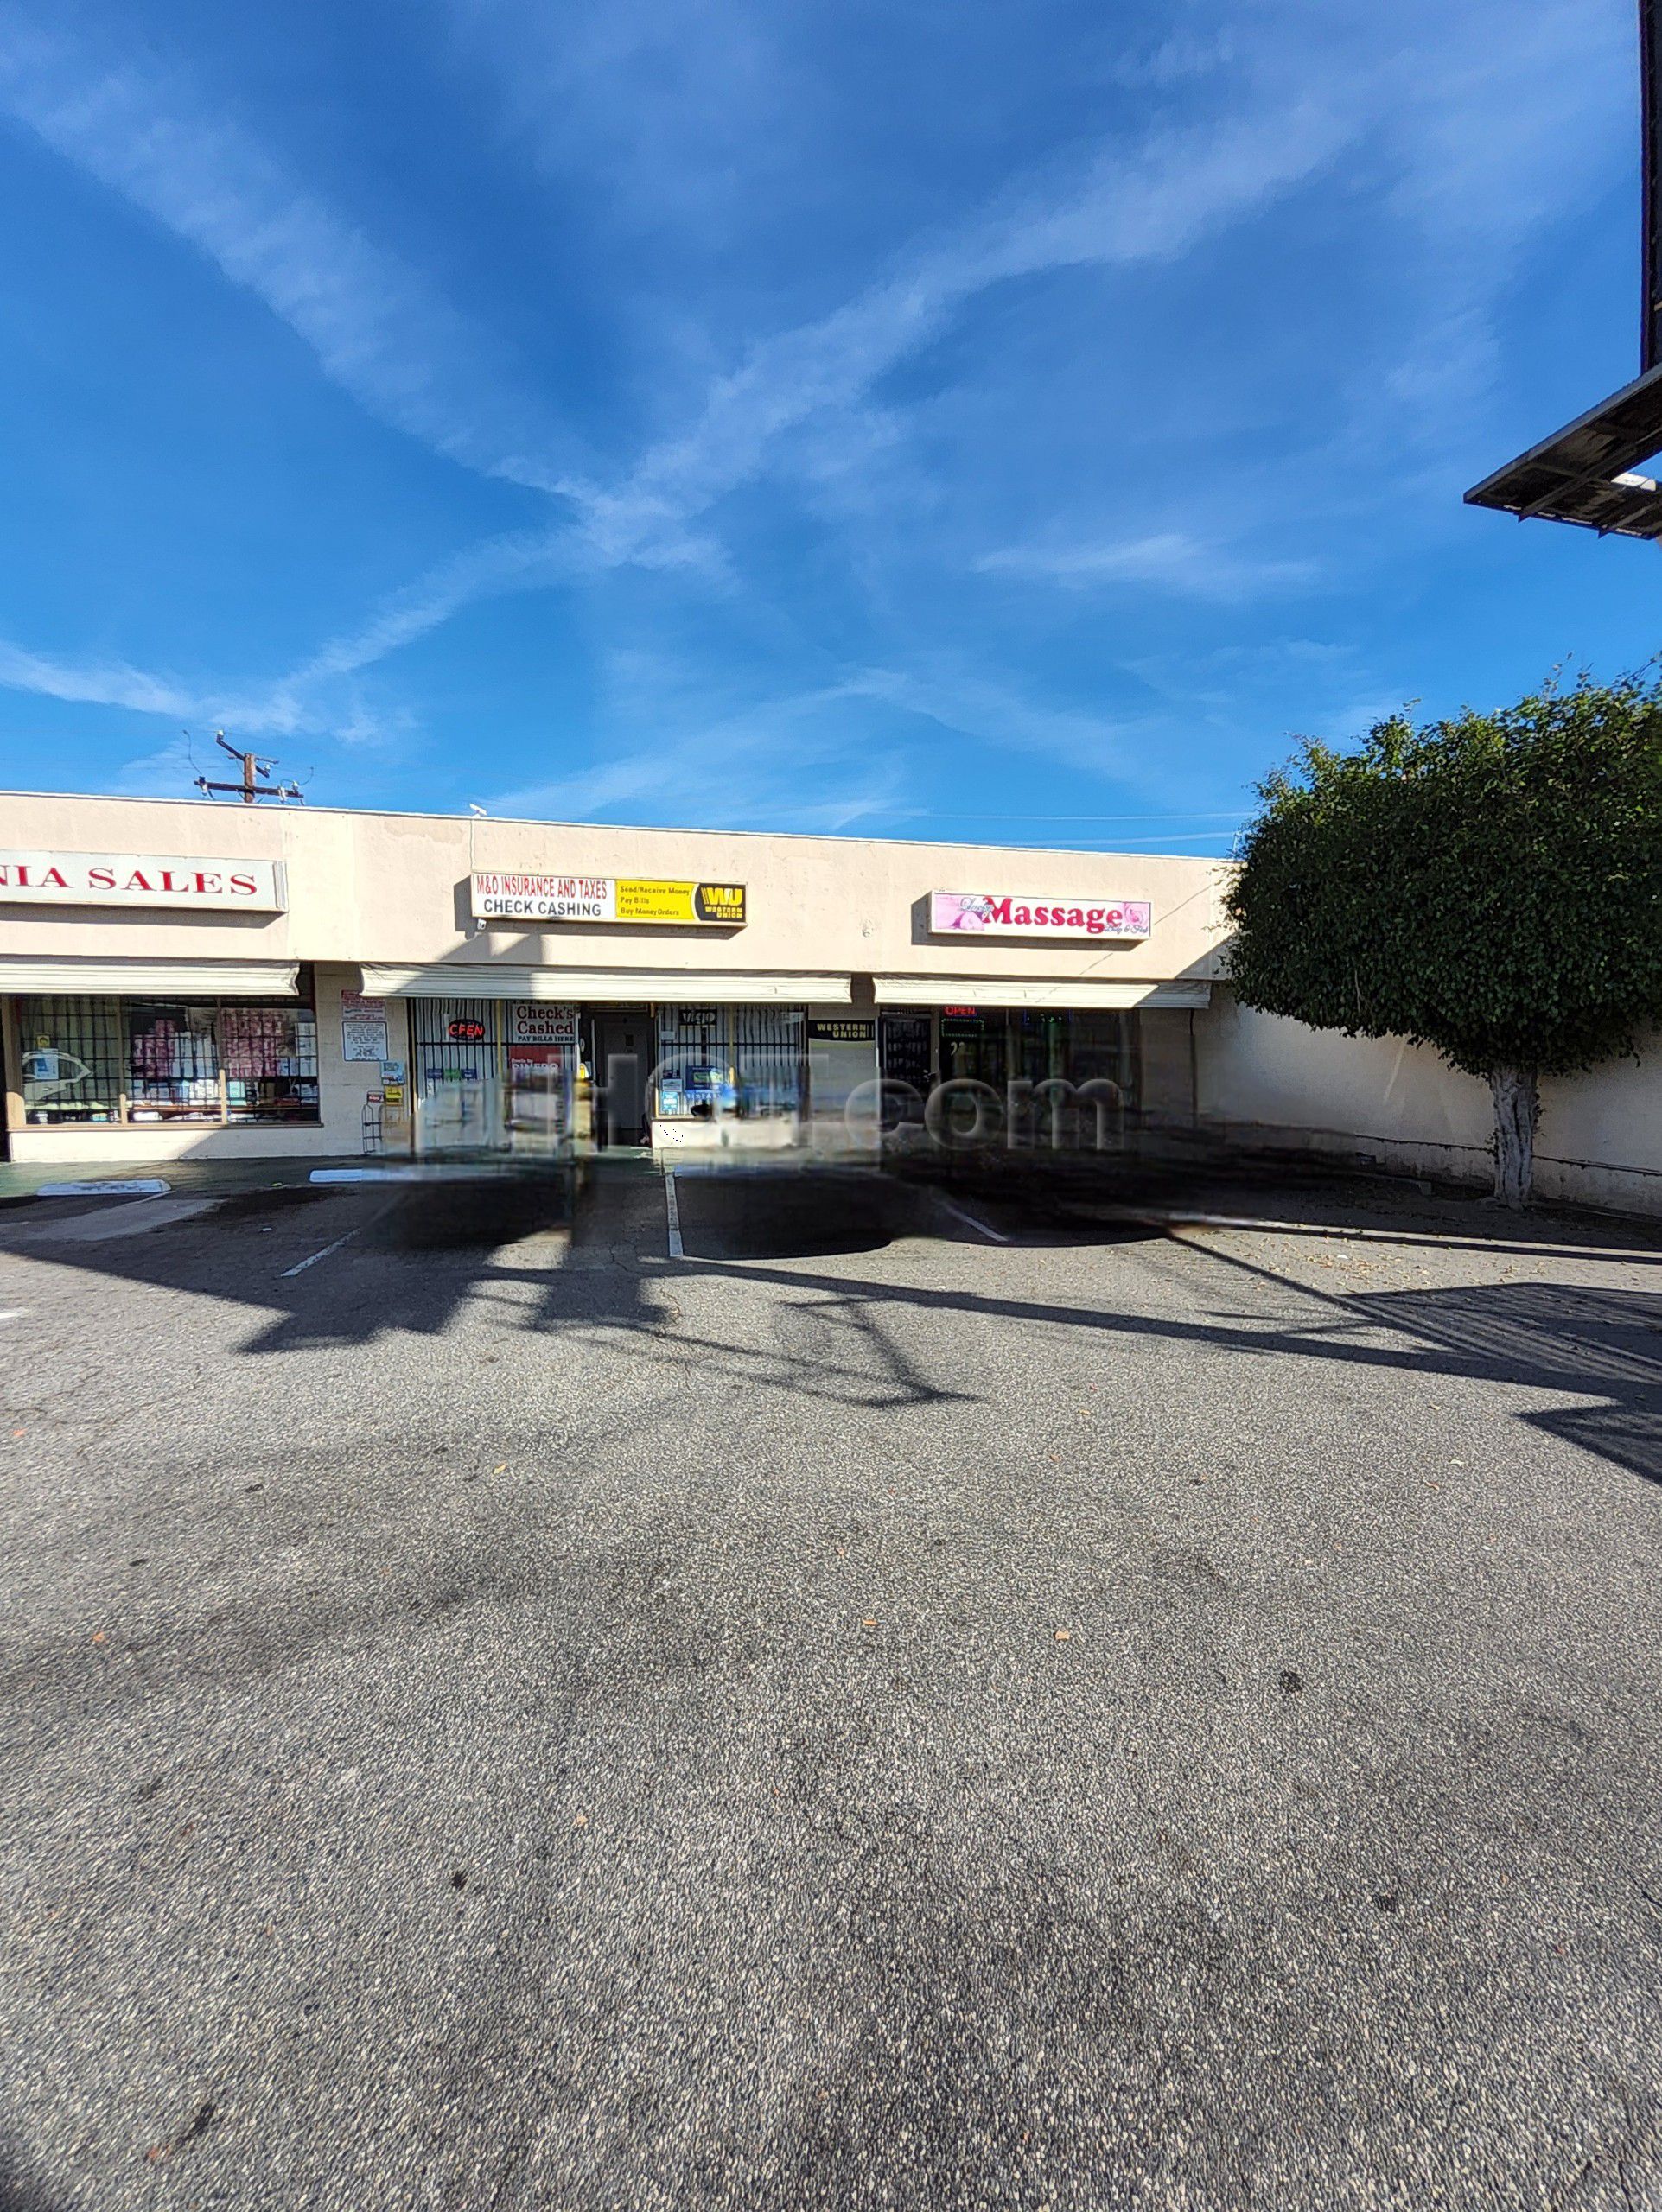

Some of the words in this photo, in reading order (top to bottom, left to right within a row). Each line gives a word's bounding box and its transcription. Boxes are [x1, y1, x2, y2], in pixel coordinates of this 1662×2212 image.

[88, 868, 258, 896] SALES
[477, 874, 499, 895] M&O
[501, 875, 555, 897] INSURANCE
[557, 878, 576, 899] AND
[578, 880, 608, 899] TAXES
[620, 886, 666, 894] Send/Receive
[701, 887, 743, 906] WU
[484, 899, 533, 914] CHECK
[538, 901, 602, 917] CASHING
[620, 896, 633, 905] Pay
[982, 895, 1124, 934] Massage
[516, 1005, 574, 1020] Check's
[946, 1005, 975, 1016] OPEN
[517, 1020, 575, 1035] Cashed
[817, 1023, 867, 1032] WESTERN
